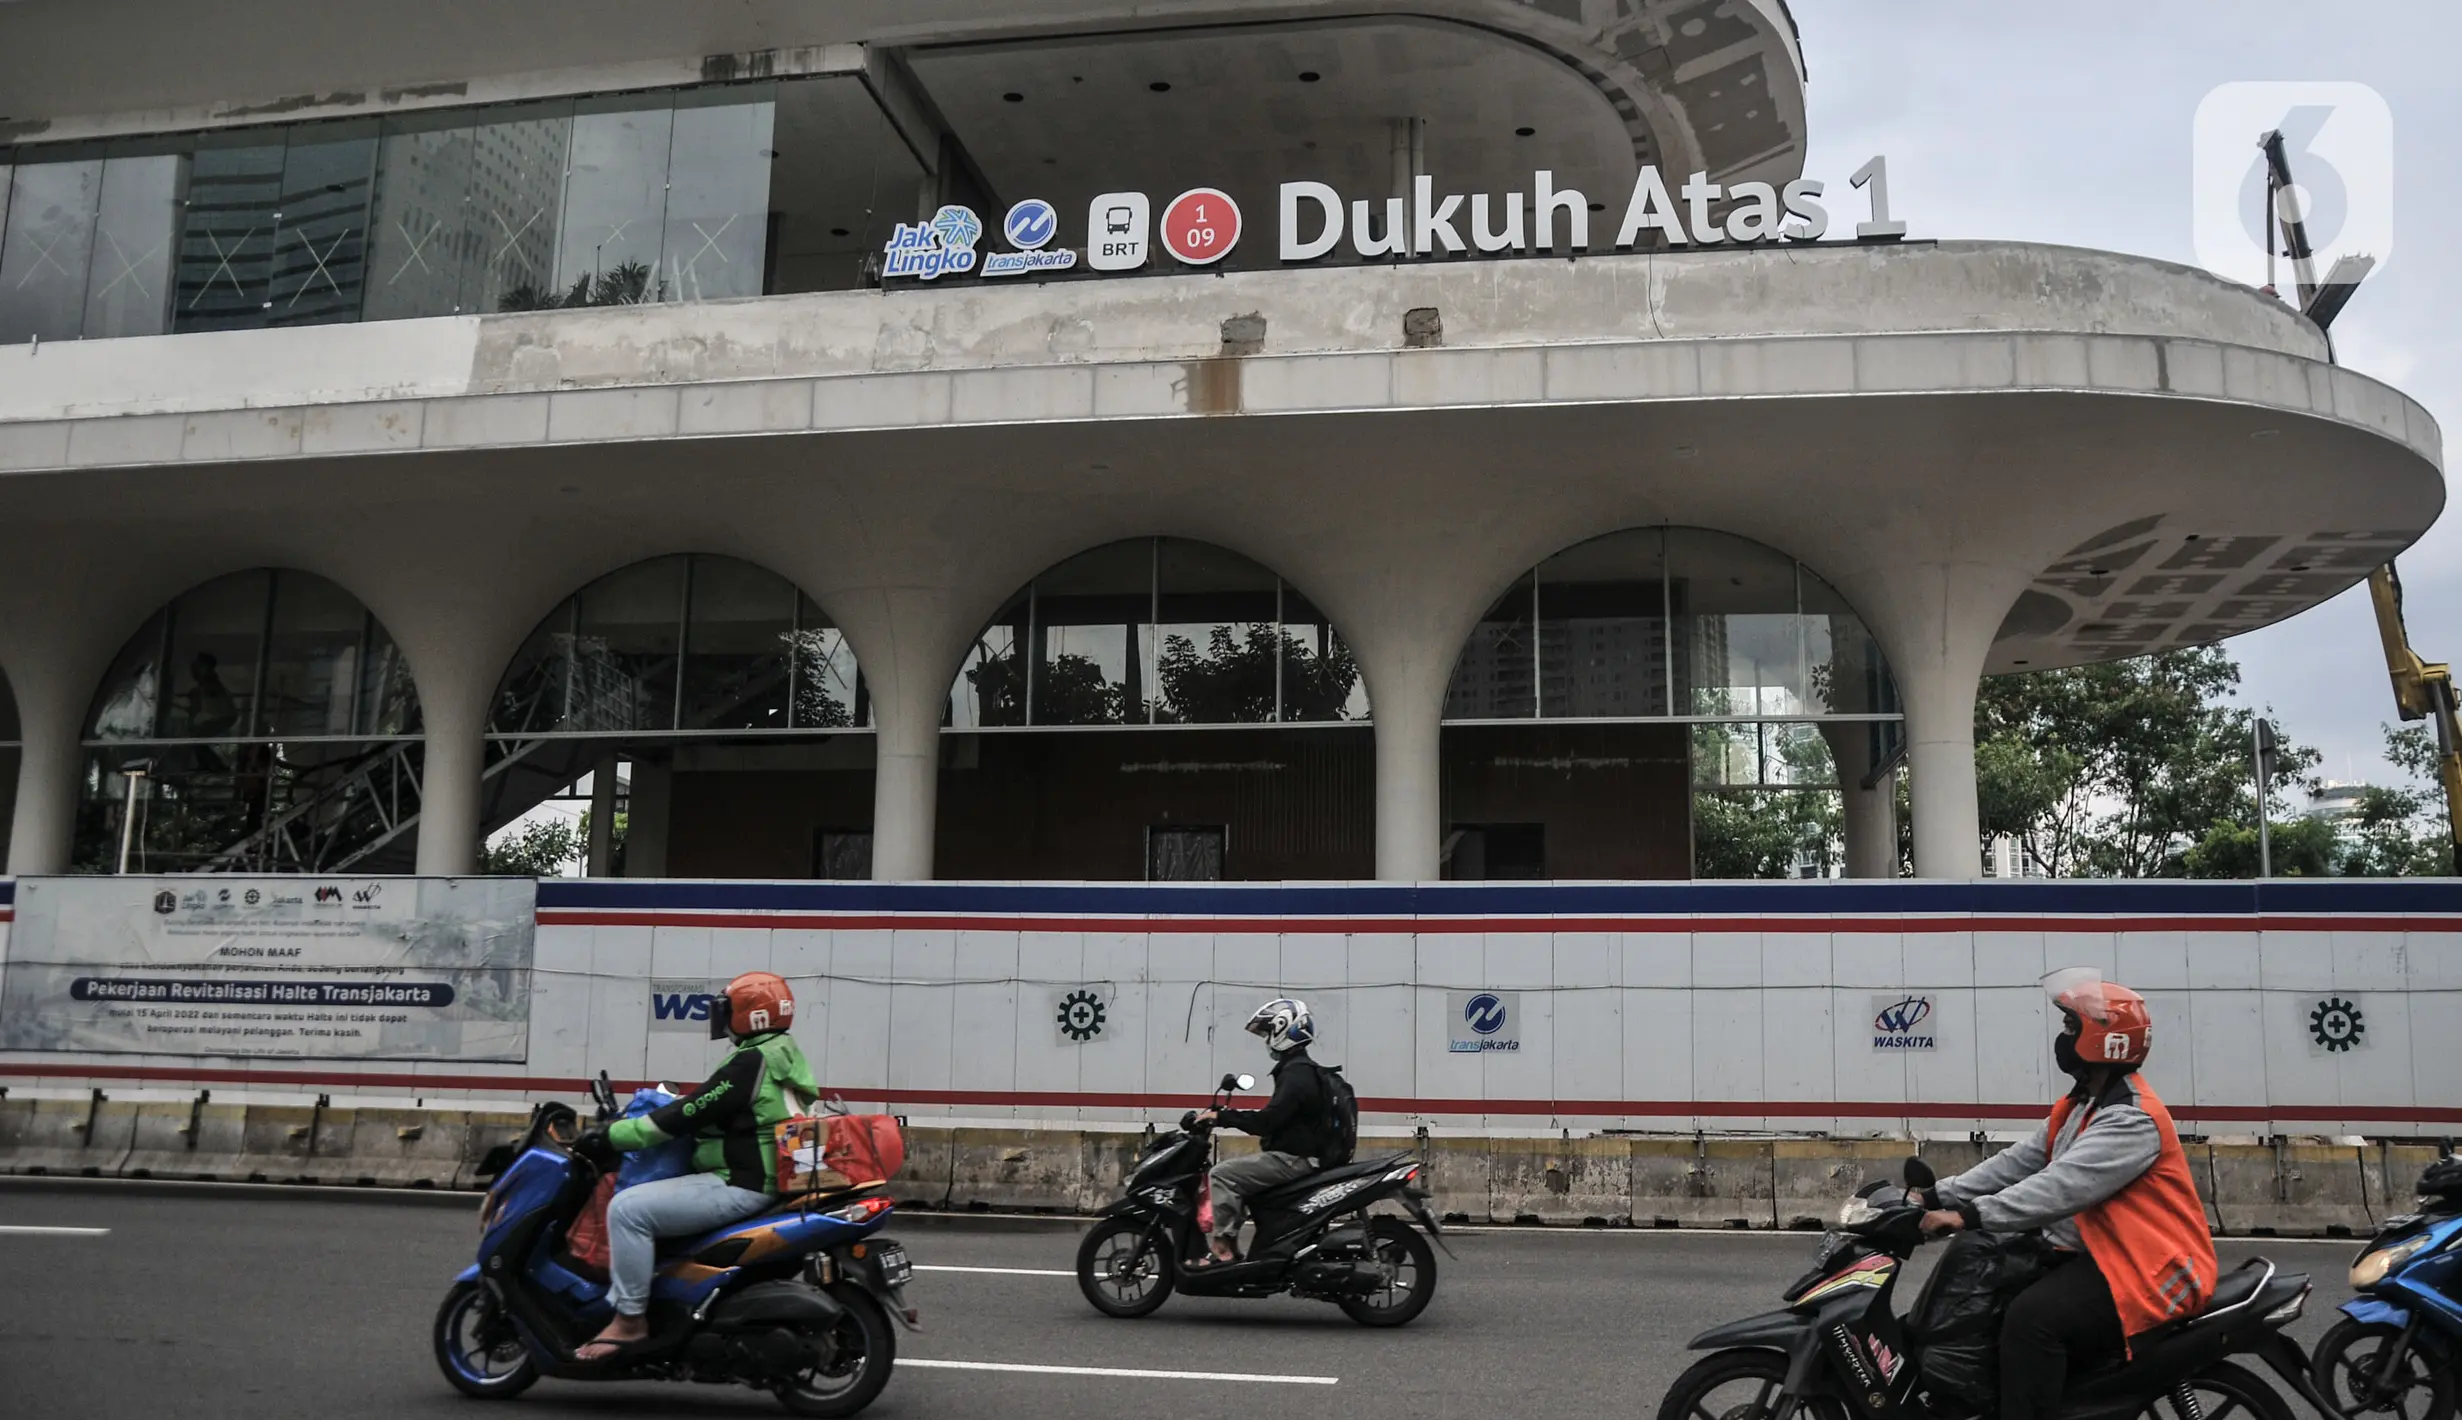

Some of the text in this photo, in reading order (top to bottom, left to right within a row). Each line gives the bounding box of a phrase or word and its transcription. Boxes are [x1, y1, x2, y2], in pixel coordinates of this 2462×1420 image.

[1195, 204, 1208, 223] 1
[1279, 155, 1908, 261] Dukuh Atas 1
[889, 225, 936, 249] Jak
[1186, 227, 1216, 248] 09
[1102, 242, 1139, 256] BRT
[887, 248, 973, 276] Lingko
[986, 250, 1073, 271] transjakarta
[219, 947, 302, 957] MOHON MAAF
[87, 981, 431, 1003] Pekerjaan Revitalisasi Halte Transjakarta
[136, 1008, 147, 1017] 15
[150, 1009, 173, 1020] April
[174, 1009, 200, 1018] 2022
[202, 1010, 219, 1019] dan
[274, 1011, 305, 1020] waktu
[307, 1012, 333, 1021] Halte
[335, 1012, 348, 1021] ini
[350, 1013, 376, 1022] tidak
[378, 1013, 407, 1024] dapat
[199, 1026, 241, 1035] melayani
[299, 1027, 332, 1037] Terima
[1449, 1039, 1520, 1053] transjakarta
[1873, 1036, 1934, 1048] WASKITA
[695, 1080, 735, 1110] gojek
